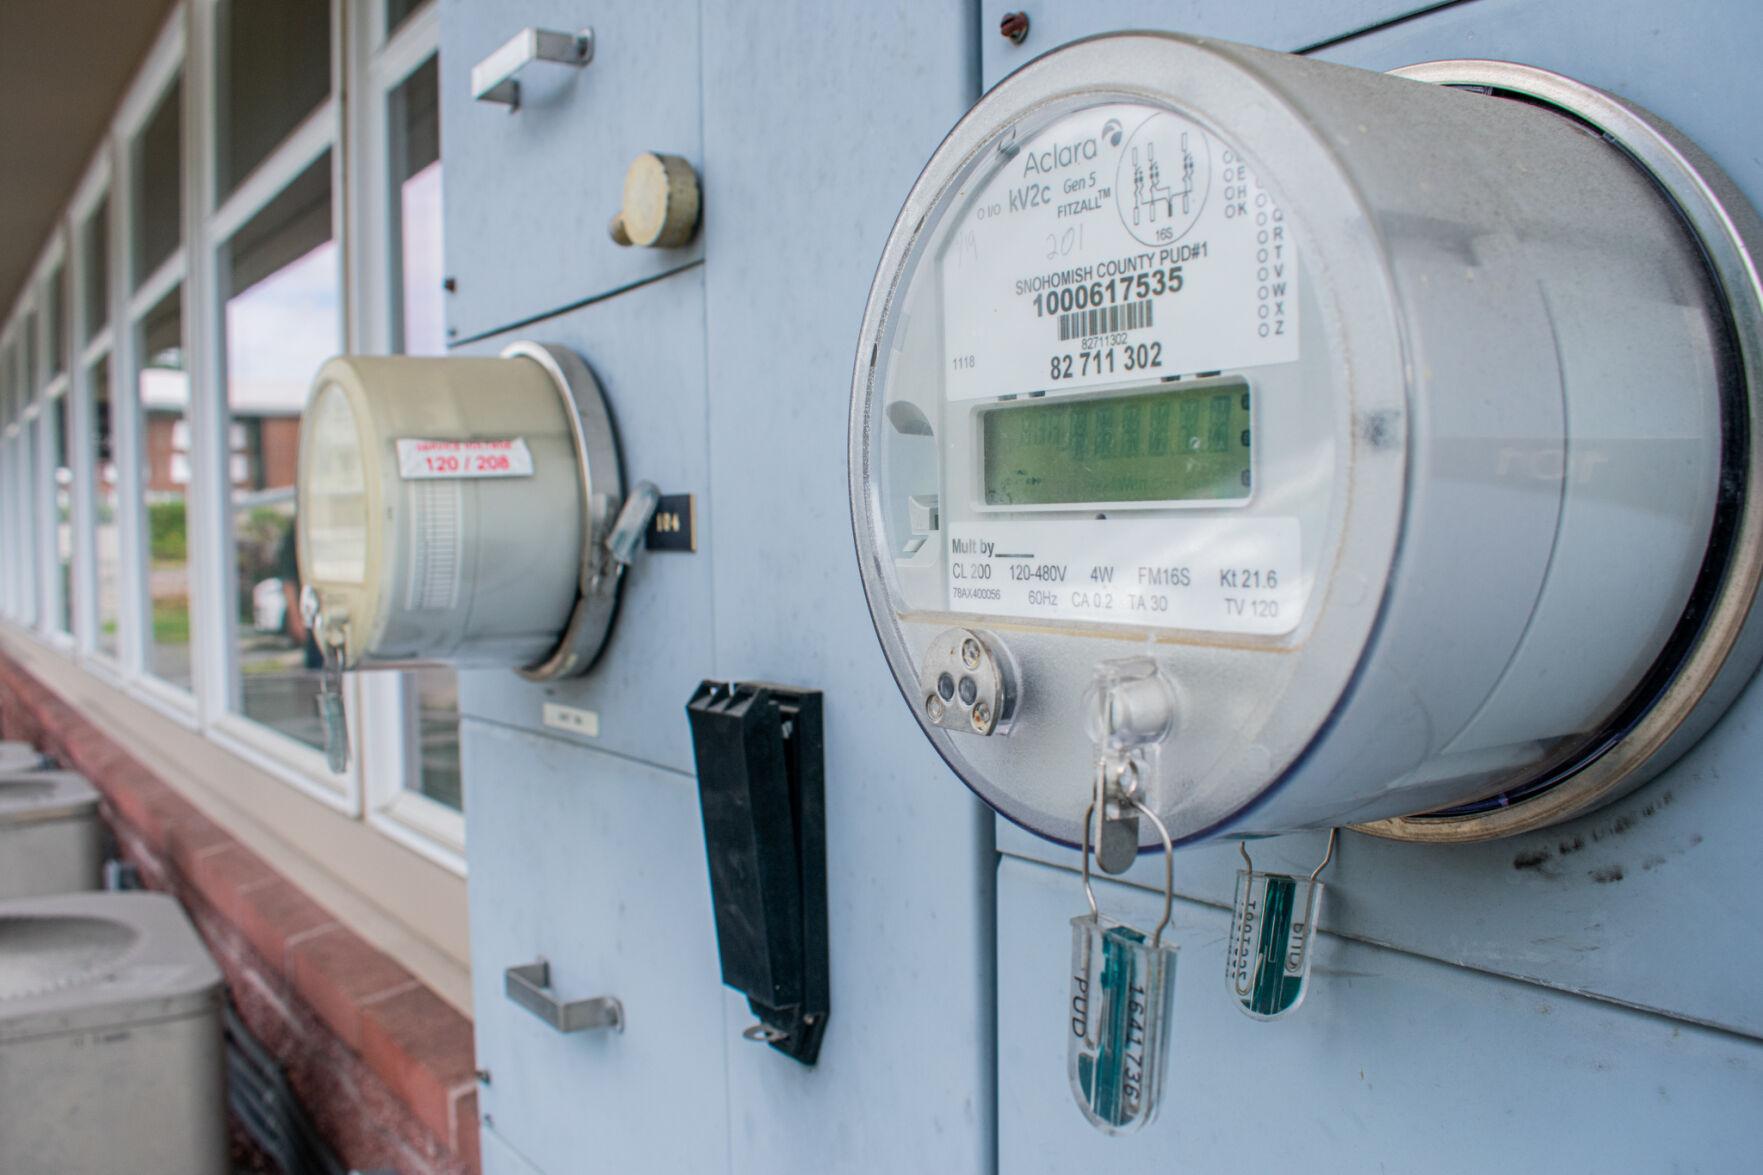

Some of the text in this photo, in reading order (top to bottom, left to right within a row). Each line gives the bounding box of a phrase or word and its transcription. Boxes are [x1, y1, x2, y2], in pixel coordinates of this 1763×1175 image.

[1023, 138, 1097, 178] Aclara
[1063, 171, 1097, 194] Gen 5
[1009, 182, 1051, 213] kV2c
[1237, 185, 1247, 199] H
[1237, 203, 1247, 216] K
[1273, 226, 1284, 241] R
[1274, 245, 1283, 259] T
[1015, 241, 1208, 296] SNOHOMISH COUNTY PUD#1
[1273, 263, 1284, 278] V
[1033, 266, 1184, 317] 1000617535
[1272, 282, 1286, 297] W
[1274, 302, 1284, 316] X
[1275, 320, 1284, 335] Z
[1081, 332, 1128, 350] 82711302
[952, 355, 976, 370] 1118
[1050, 341, 1162, 380] 82 711 302
[426, 456, 459, 472] 120
[952, 563, 1278, 589] CL 200 120-480V 4W FM16S Kt 21.6
[1028, 590, 1059, 606] 60Hz
[1071, 591, 1090, 608] CA
[1128, 594, 1147, 611] TA
[1150, 595, 1168, 612] 30
[1224, 598, 1245, 616] TV
[1251, 599, 1279, 618] 120
[1072, 976, 1089, 1038] PUD
[1124, 982, 1145, 1100] 1641736
